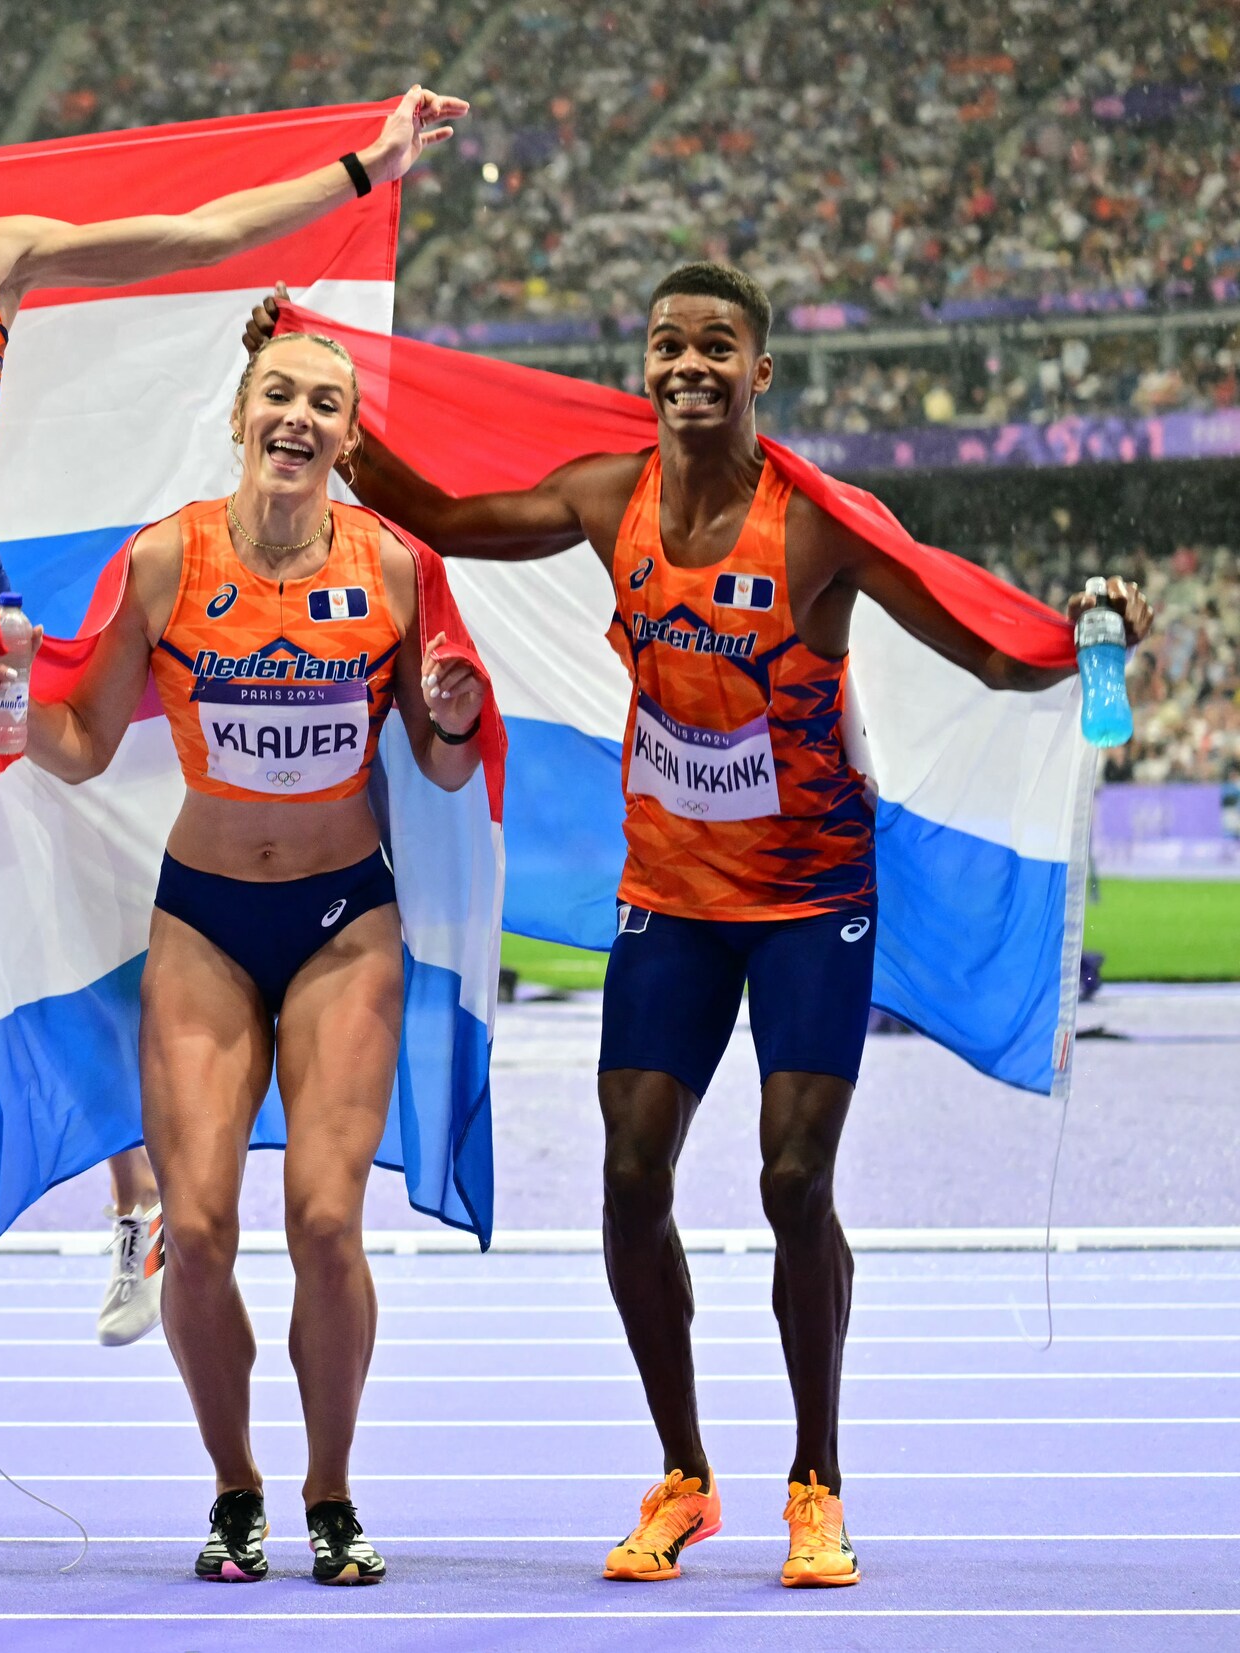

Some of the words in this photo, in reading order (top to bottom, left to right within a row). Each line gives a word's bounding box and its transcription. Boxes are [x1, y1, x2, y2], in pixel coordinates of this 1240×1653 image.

[631, 611, 758, 658] Nederland
[192, 649, 369, 681] Nederland
[241, 689, 282, 700] PARIS
[288, 690, 325, 700] 2024
[212, 722, 358, 759] KLAVER
[661, 713, 688, 740] PARIS
[693, 731, 729, 746] 2024
[635, 726, 680, 784] KLEIN
[686, 753, 769, 794] IKKINK
